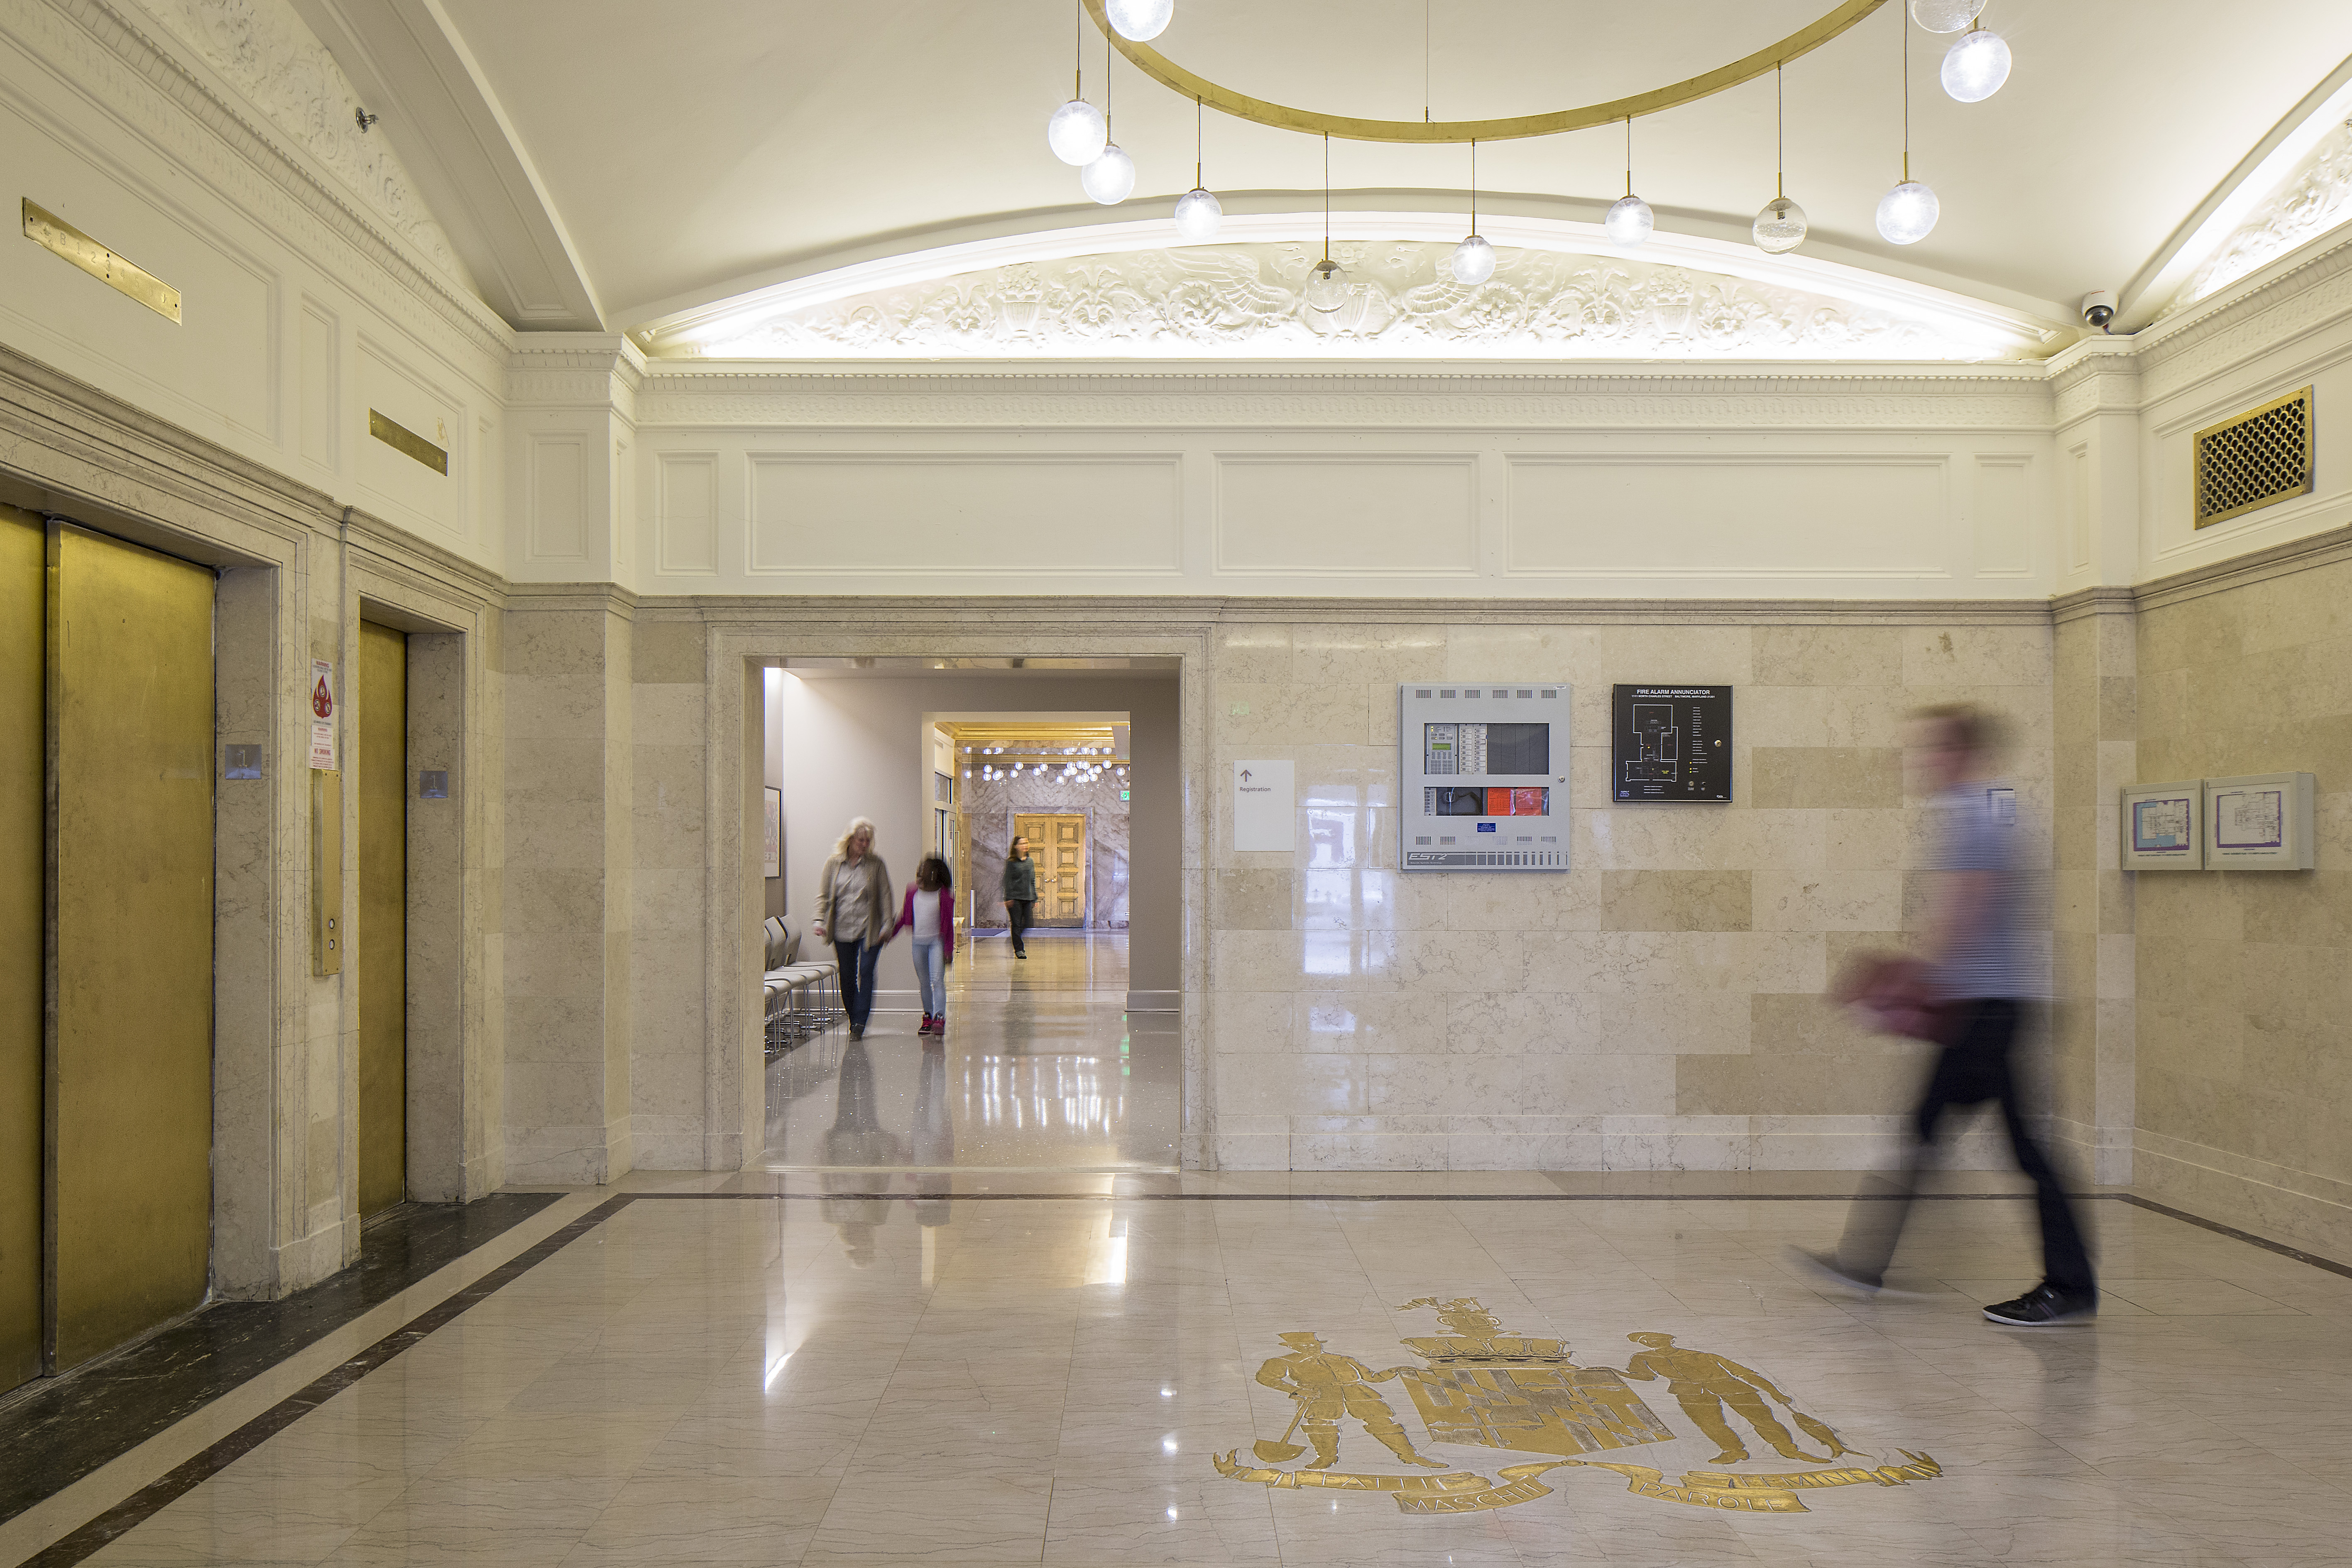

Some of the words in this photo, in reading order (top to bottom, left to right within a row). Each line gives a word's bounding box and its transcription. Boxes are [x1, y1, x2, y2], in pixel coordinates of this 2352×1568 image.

[60, 232, 66, 246] B
[76, 242, 81, 255] 1
[91, 251, 97, 264] 2
[237, 750, 247, 769] 1
[1322, 1474, 1428, 1489] FATTI
[1739, 1469, 1869, 1488] FEMINE
[1401, 1482, 1542, 1511] MASCHII
[1639, 1482, 1789, 1511] PAROLE
